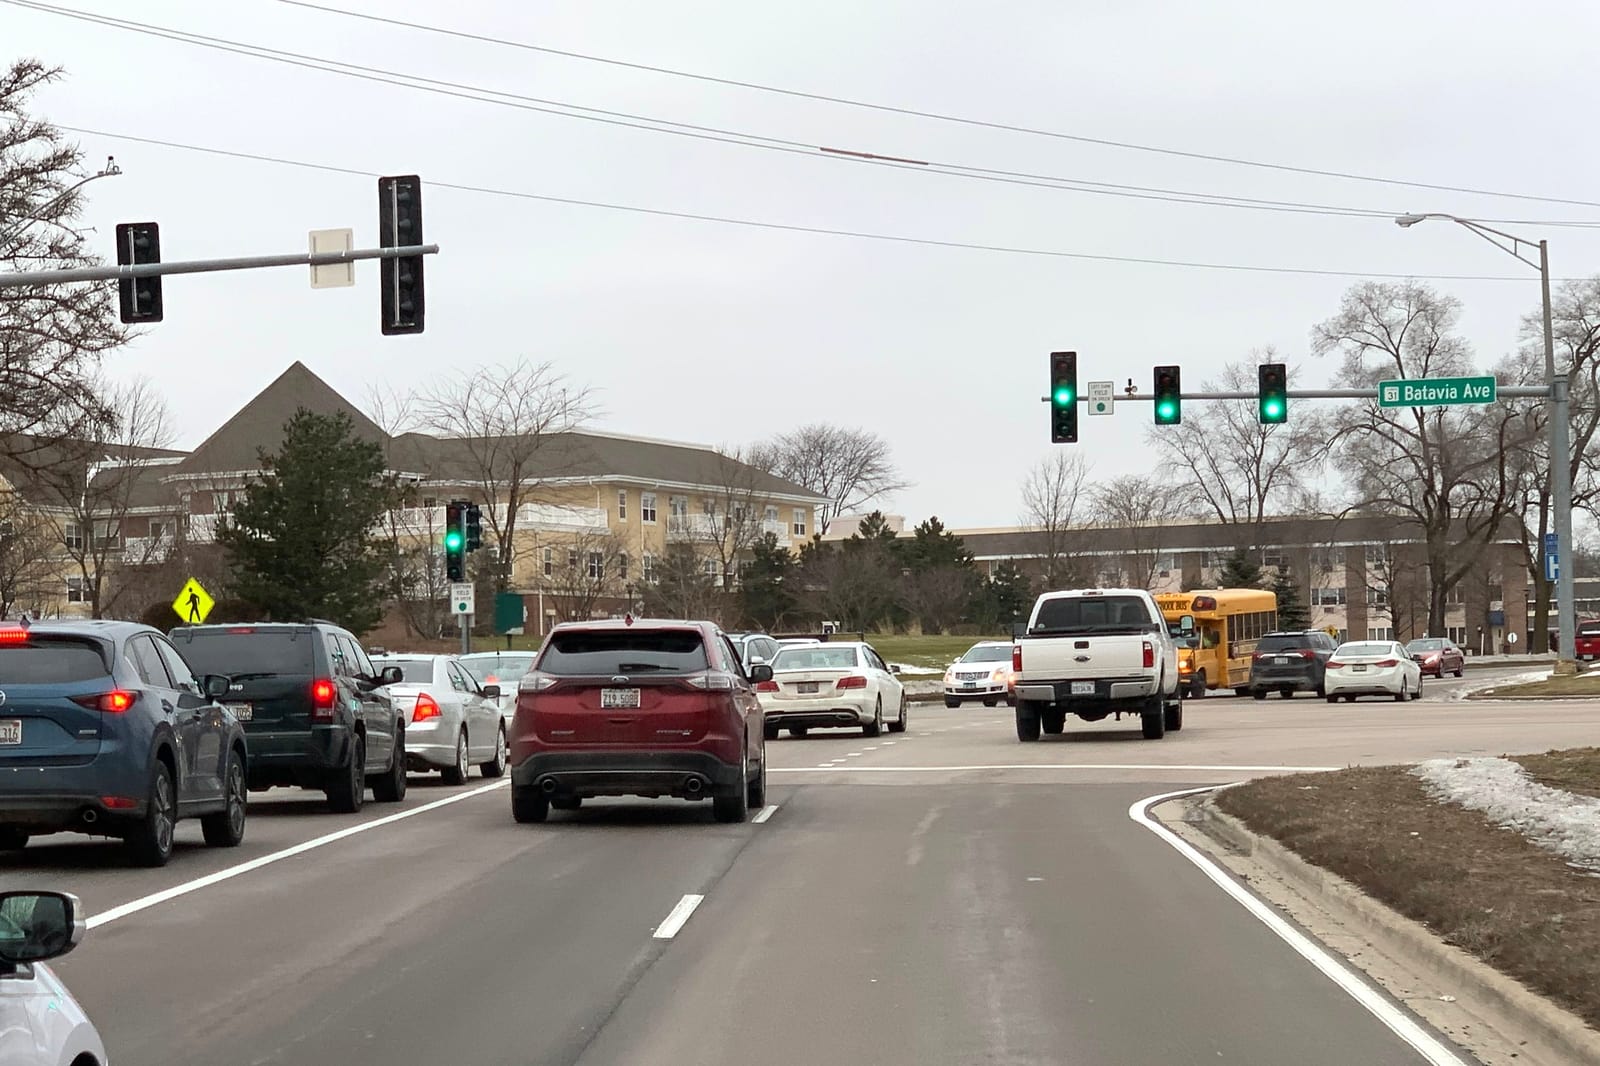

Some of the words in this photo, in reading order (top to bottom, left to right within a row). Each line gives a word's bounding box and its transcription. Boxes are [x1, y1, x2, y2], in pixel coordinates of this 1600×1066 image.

[1387, 391, 1397, 400] 31
[1404, 384, 1458, 401] Batavia
[1463, 383, 1490, 399] Ave
[1175, 600, 1187, 611] BUS
